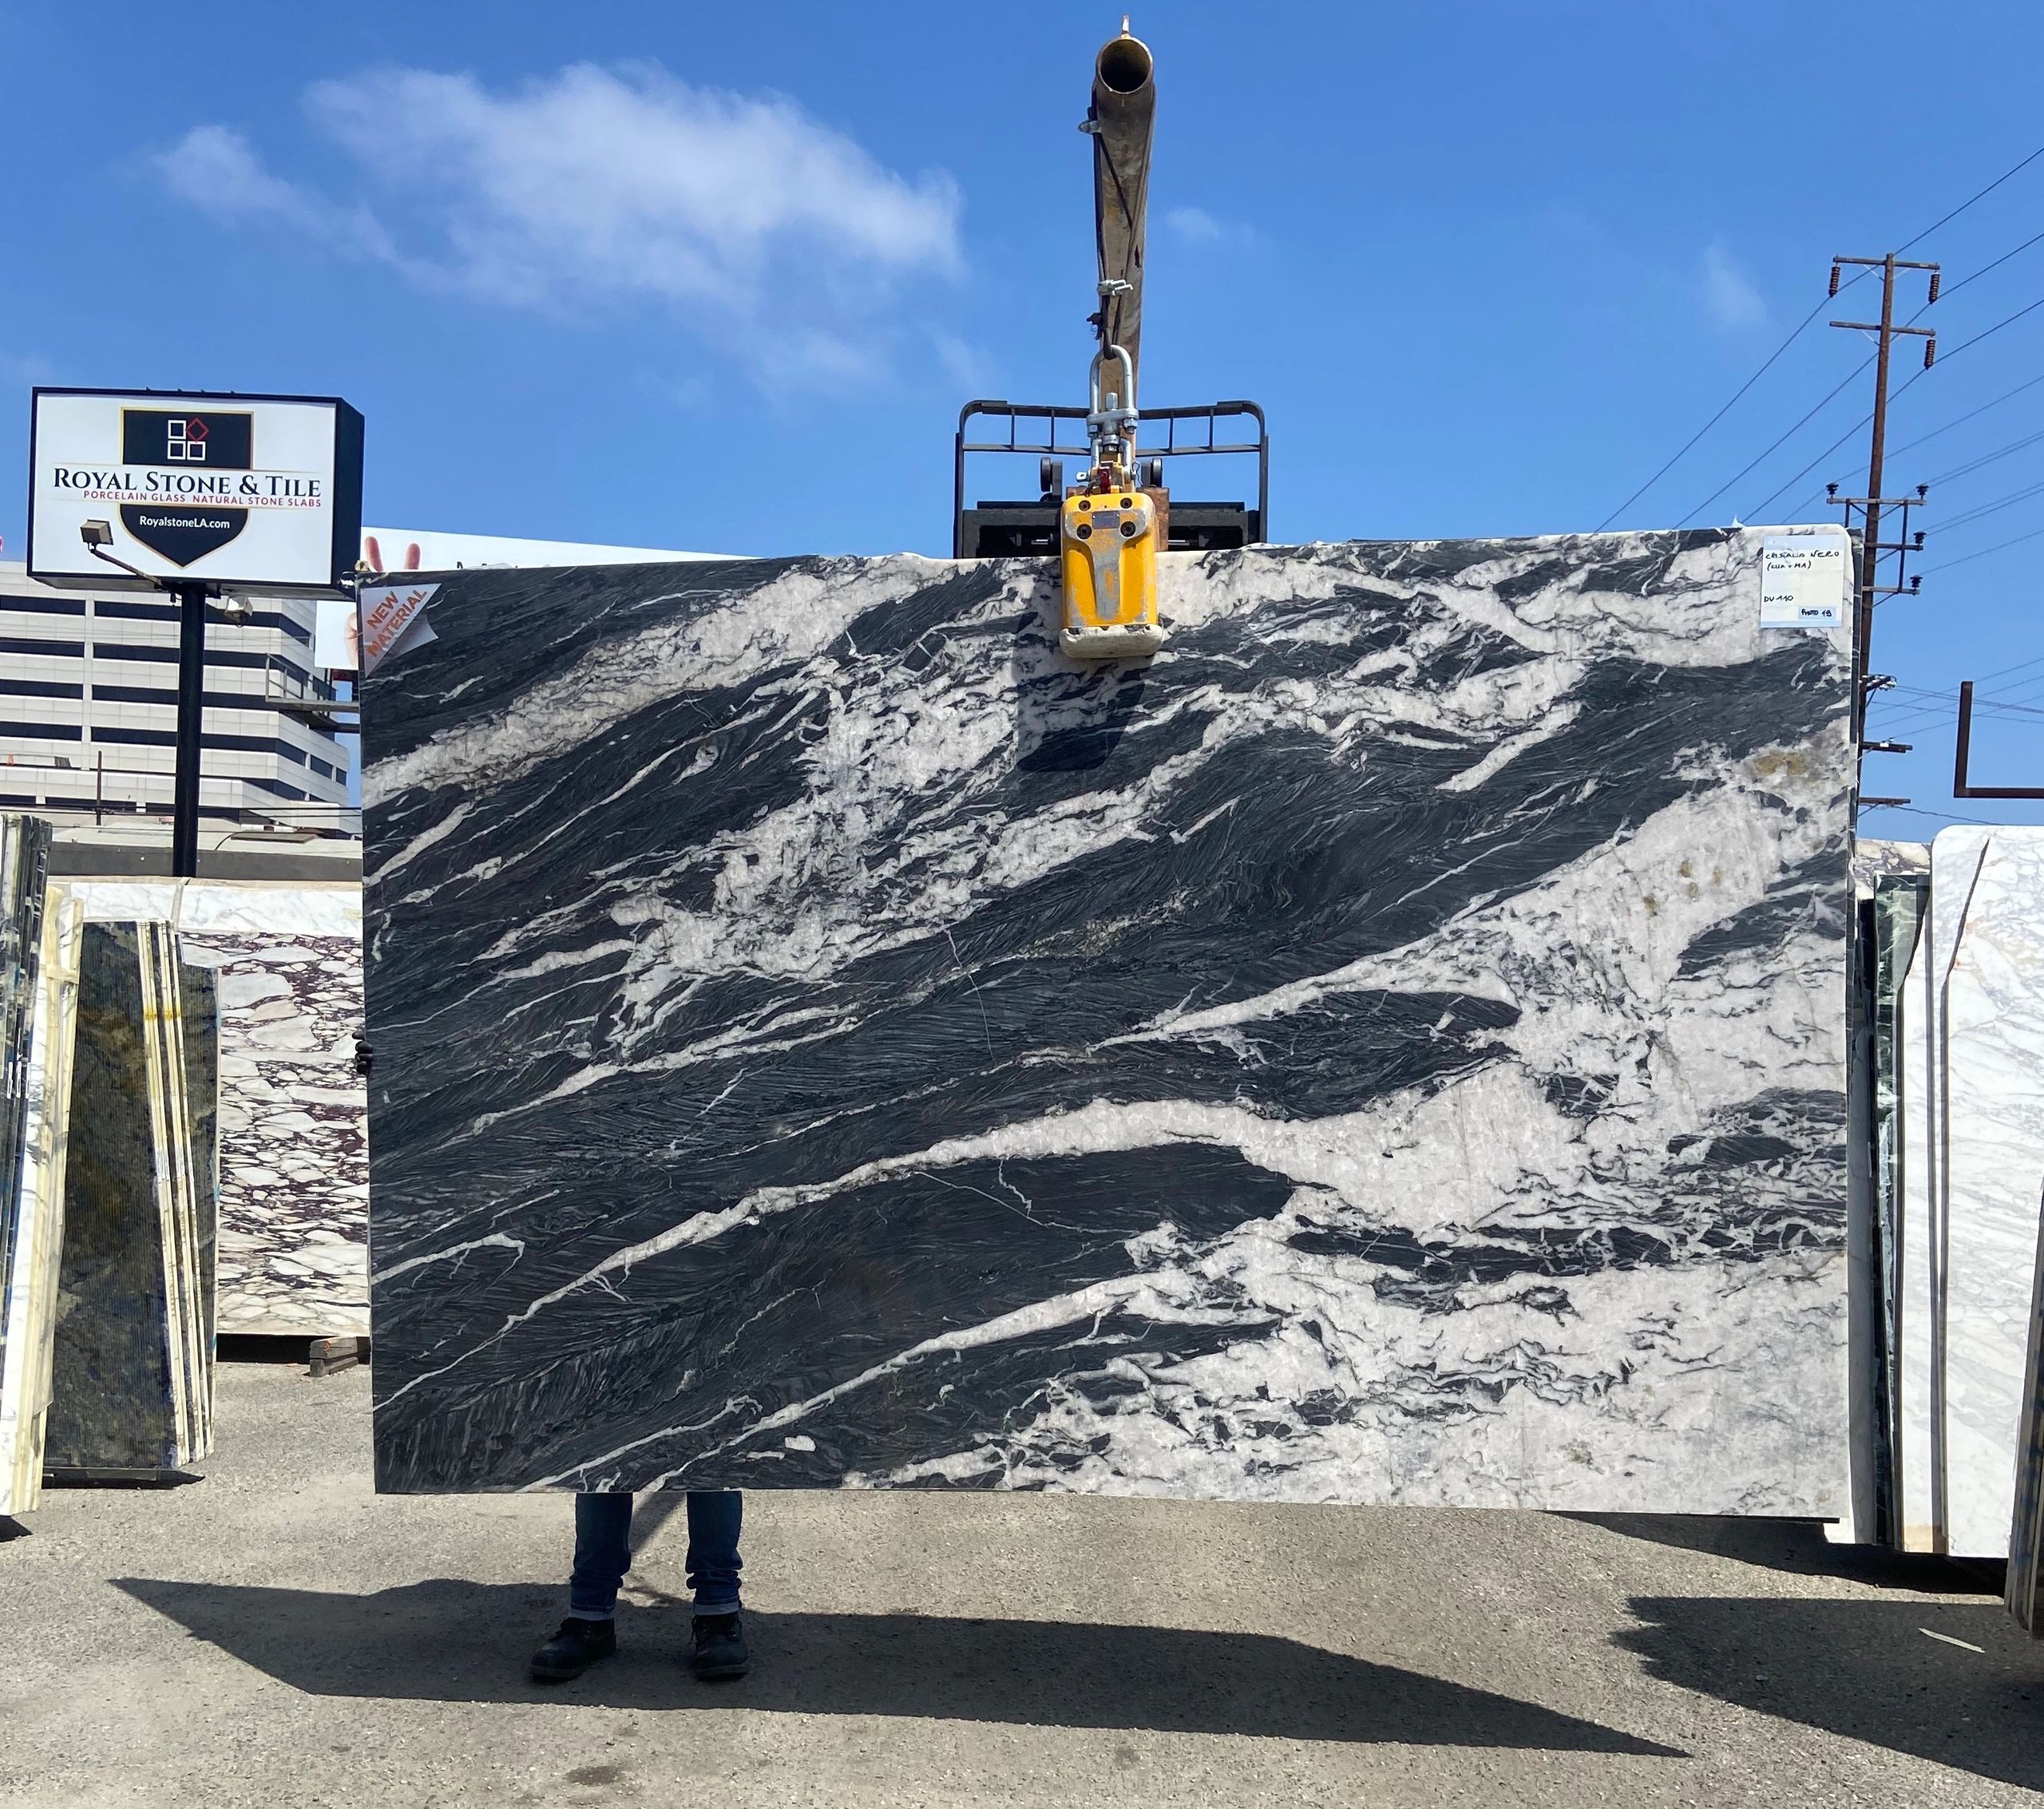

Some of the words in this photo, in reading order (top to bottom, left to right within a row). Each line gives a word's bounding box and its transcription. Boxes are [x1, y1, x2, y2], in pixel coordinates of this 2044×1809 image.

[53, 468, 137, 490] ROYAL
[145, 471, 231, 494] STONE
[239, 474, 260, 495] &
[265, 476, 321, 497] TILE
[84, 490, 147, 501] PORCELAIN
[151, 493, 186, 502] GLASS
[192, 495, 244, 505] NATURAL
[248, 497, 283, 506] STONE
[287, 498, 321, 507] SLABS
[140, 515, 230, 528] RoyalstoneLA.com
[366, 591, 398, 629] NEW
[367, 589, 427, 657] MATERIAL
